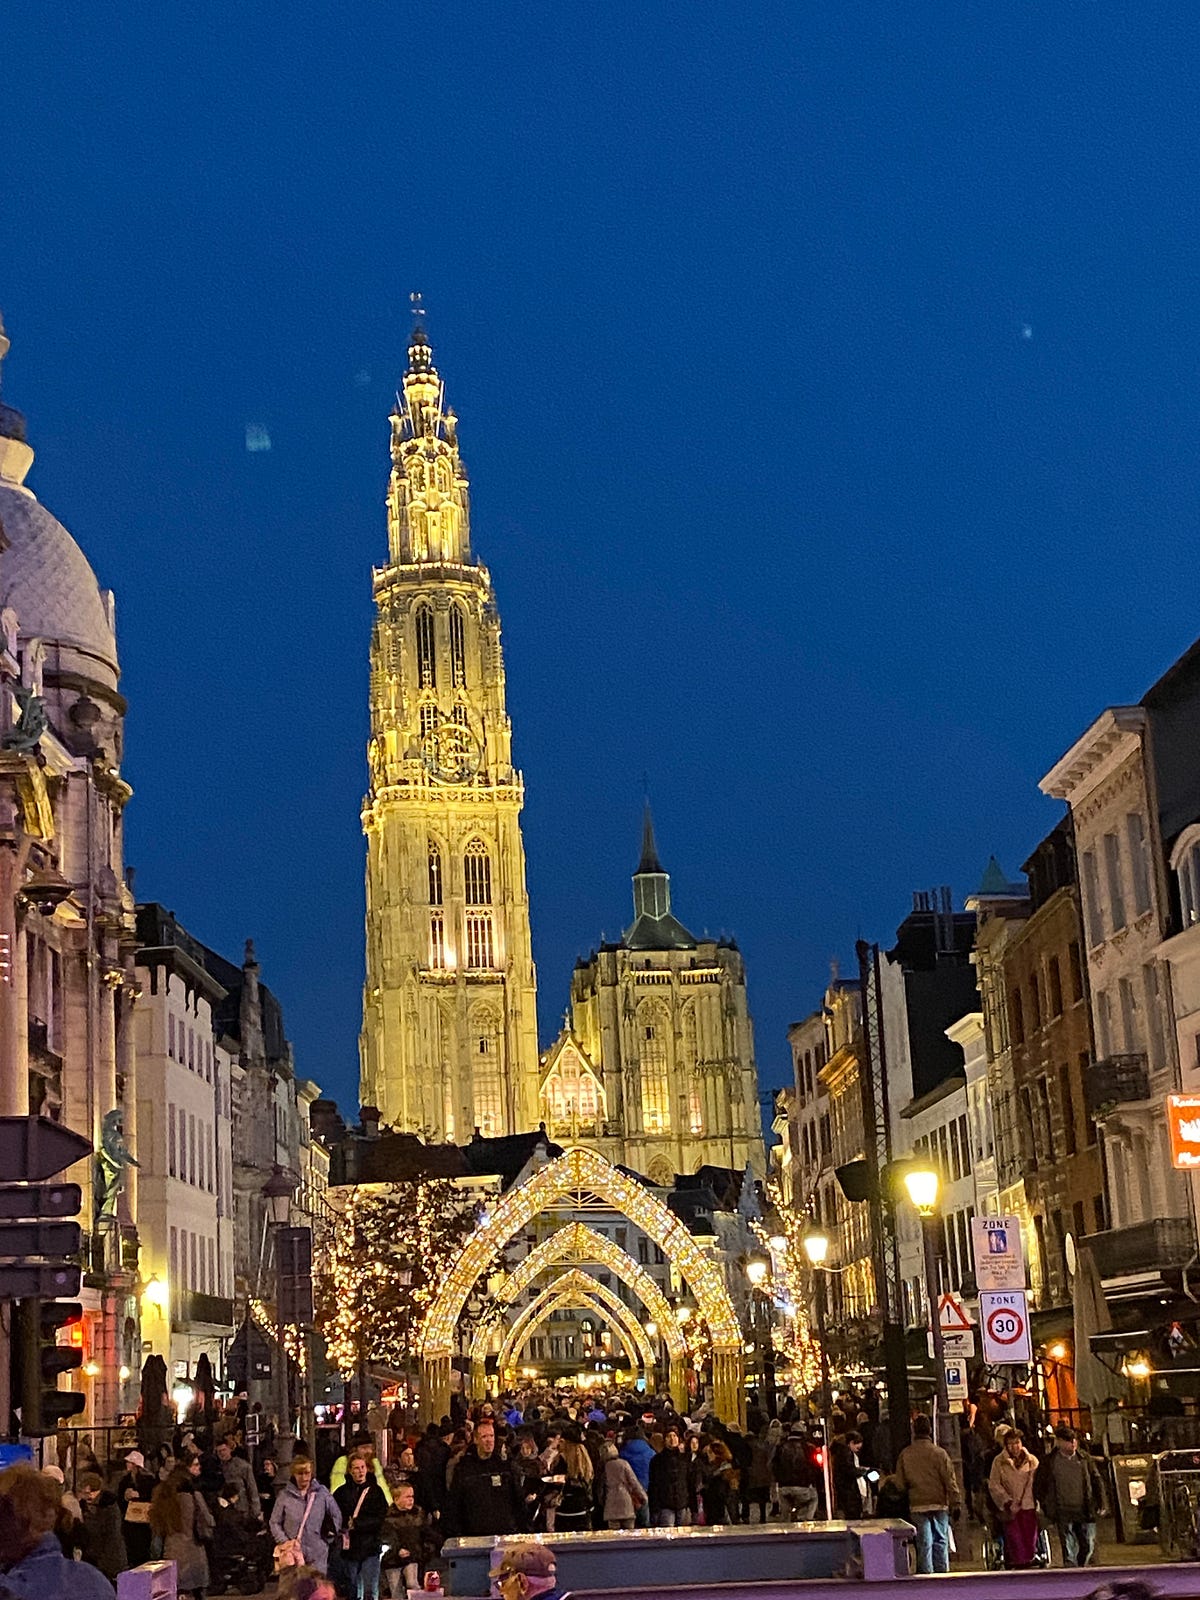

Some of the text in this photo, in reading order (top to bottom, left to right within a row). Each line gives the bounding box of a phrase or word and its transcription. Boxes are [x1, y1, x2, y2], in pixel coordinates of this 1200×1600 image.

[982, 1219, 1010, 1229] ZONE
[990, 1296, 1015, 1305] ZONE
[995, 1319, 1015, 1333] 30
[949, 1369, 958, 1381] P
